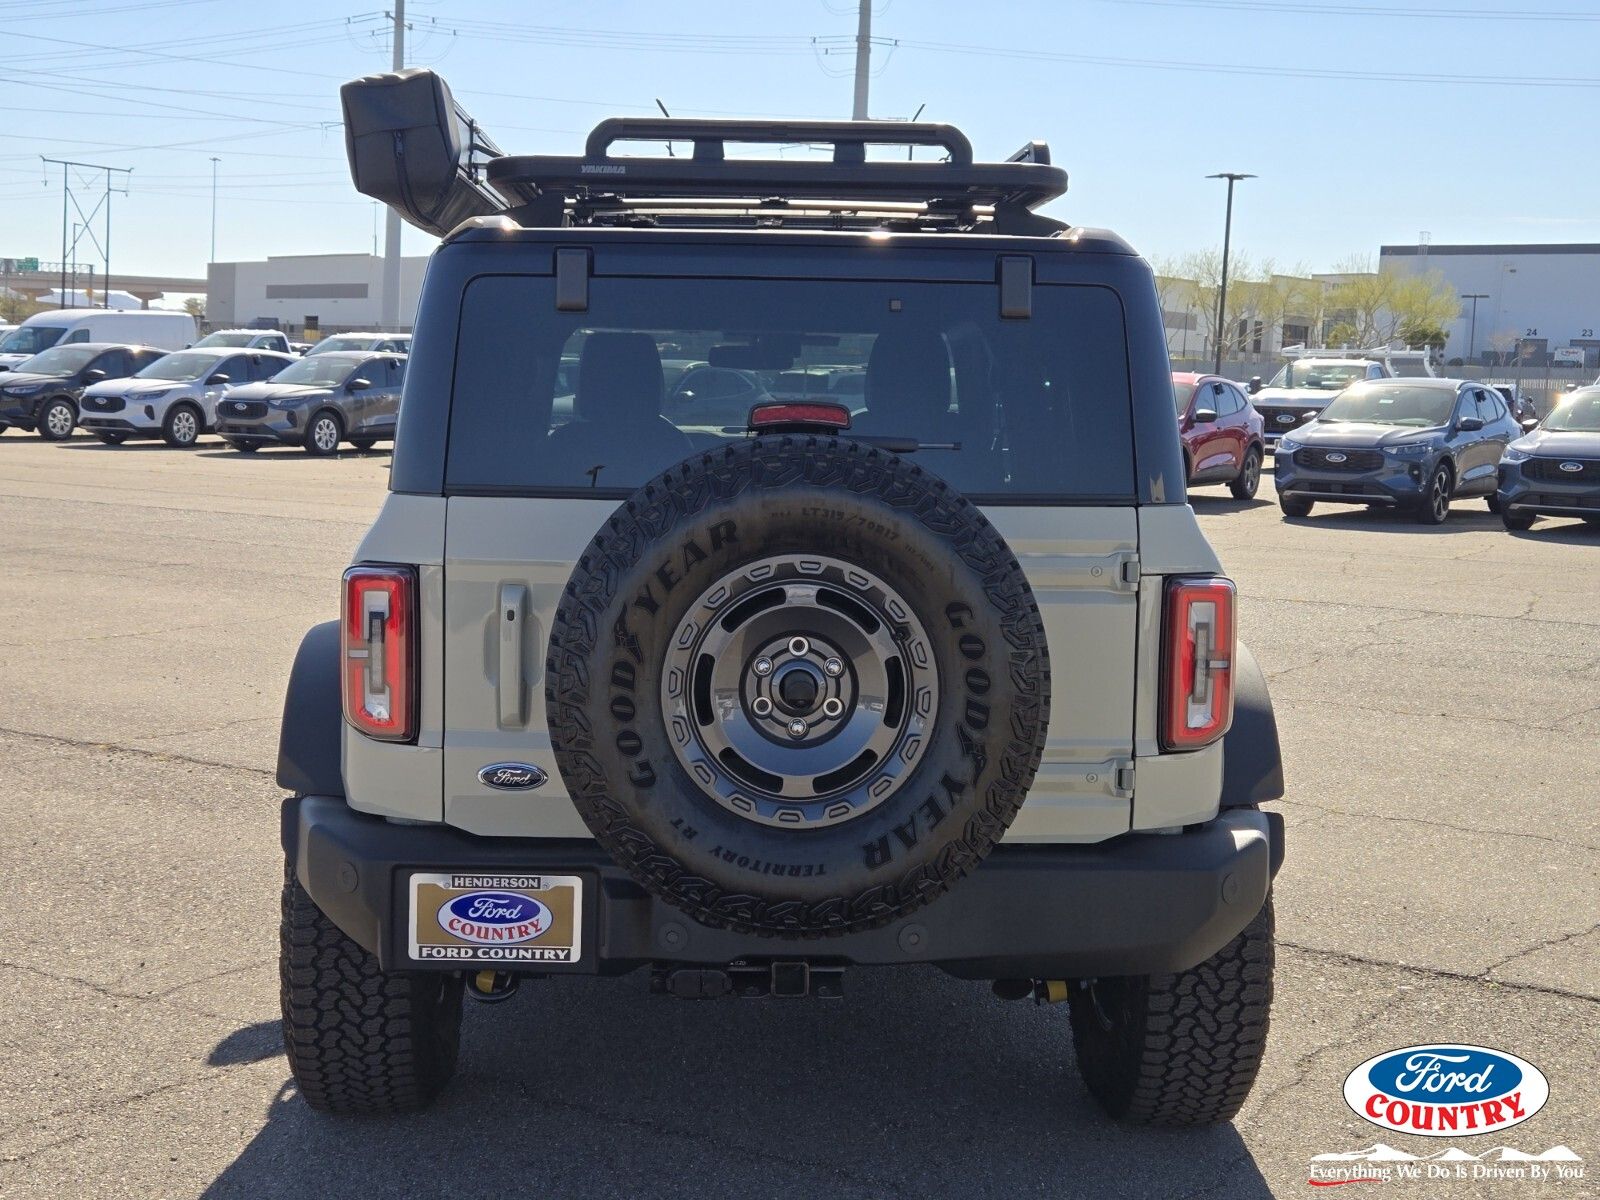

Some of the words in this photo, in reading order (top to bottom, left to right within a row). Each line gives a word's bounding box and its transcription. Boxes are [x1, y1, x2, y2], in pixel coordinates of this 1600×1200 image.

[580, 164, 626, 174] YAKIMA
[1526, 328, 1538, 337] 24
[1582, 328, 1594, 337] 23
[493, 768, 532, 785] Ford
[670, 816, 699, 841] RT
[708, 844, 828, 878] TERRITORY
[453, 876, 539, 889] HENDERSON
[468, 897, 523, 920] Ford
[448, 917, 543, 941] COUNTRY
[421, 946, 474, 959] FORD
[476, 947, 569, 961] COUNTRY
